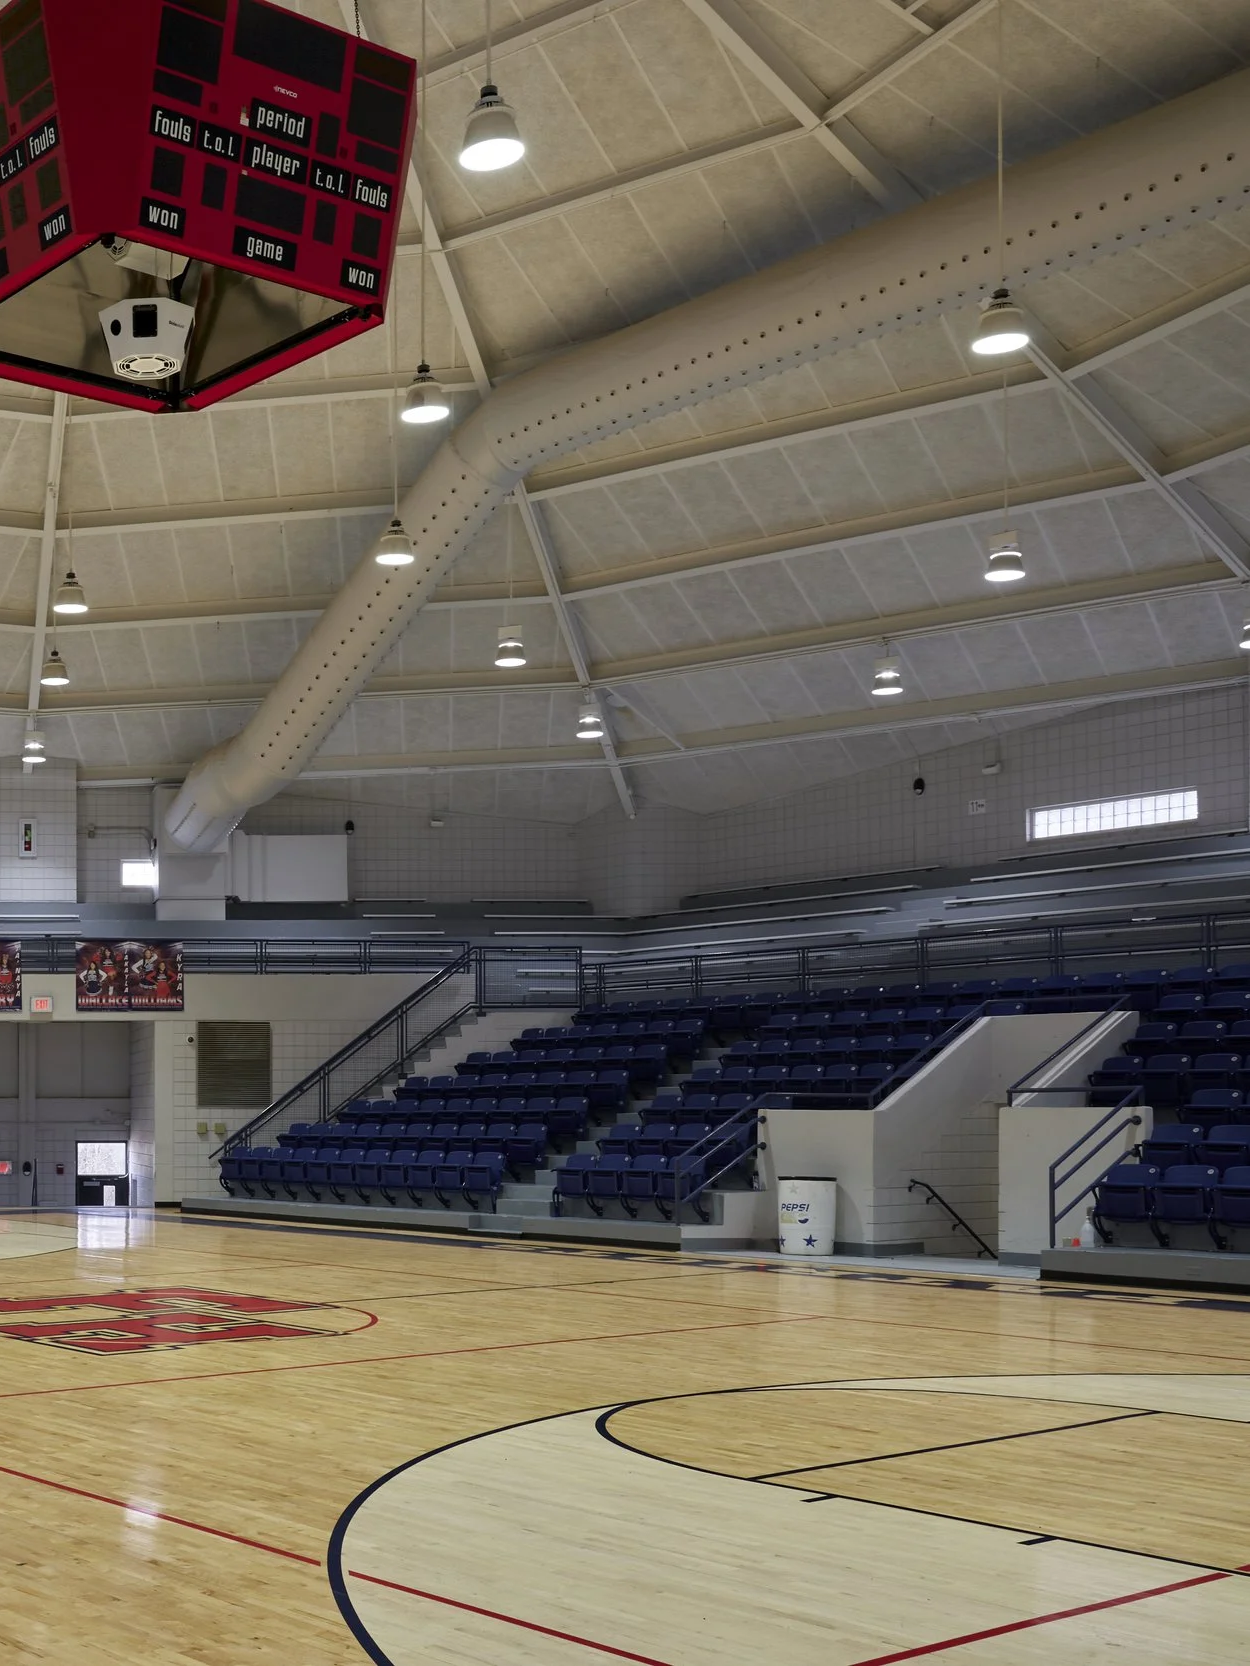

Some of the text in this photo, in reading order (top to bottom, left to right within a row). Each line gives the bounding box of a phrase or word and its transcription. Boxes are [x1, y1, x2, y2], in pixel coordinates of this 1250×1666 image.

[256, 106, 306, 138] period
[29, 126, 56, 159] fouls
[154, 110, 191, 142] fouls
[251, 145, 300, 176] player
[355, 178, 388, 208] fouls
[43, 214, 66, 241] won
[149, 205, 374, 289] won game won
[35, 999, 48, 1010] EXIT
[78, 996, 129, 1006] WALLACE
[131, 996, 183, 1006] WILLIAMS
[781, 1203, 810, 1212] PEPSI
